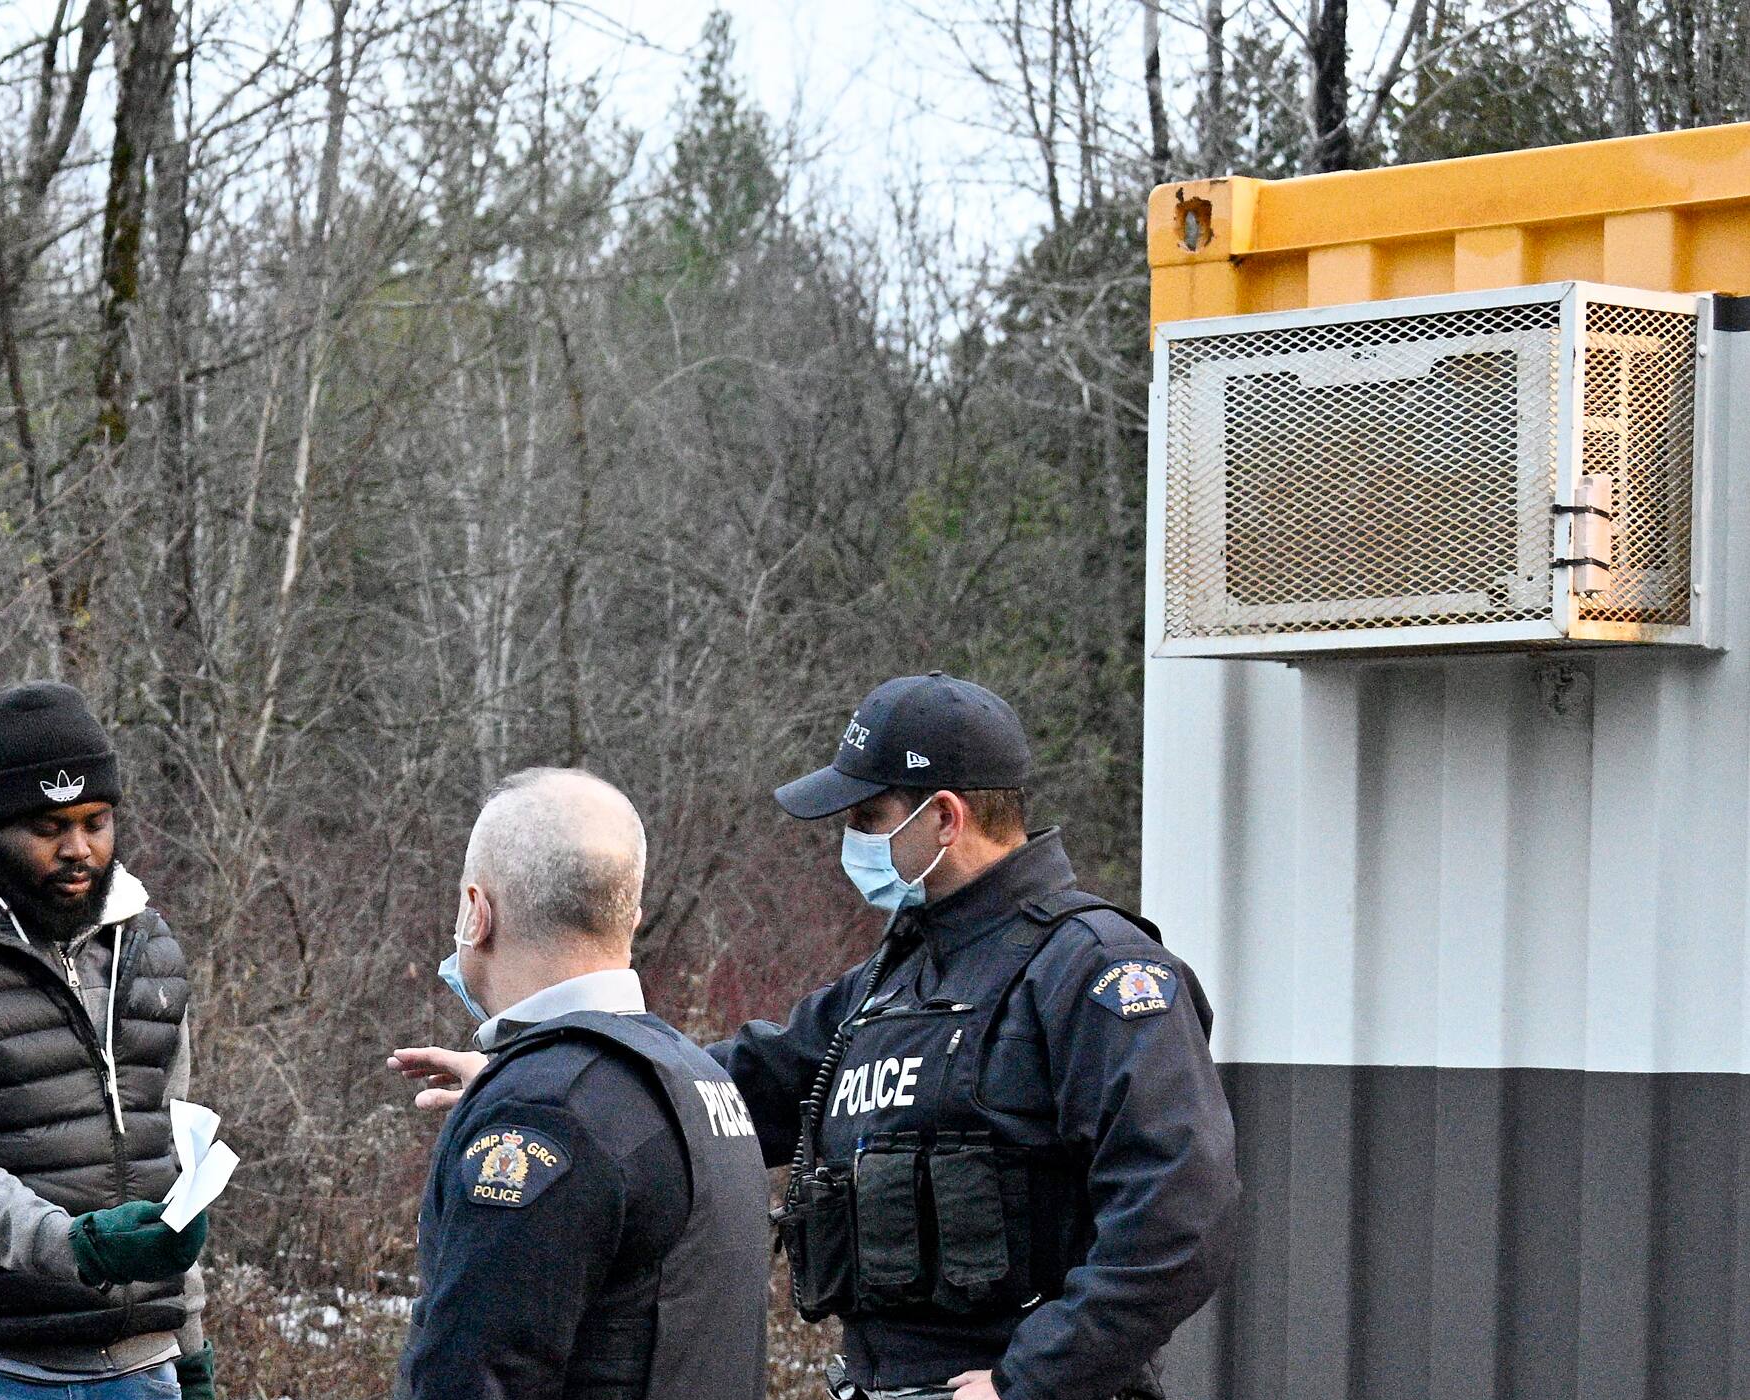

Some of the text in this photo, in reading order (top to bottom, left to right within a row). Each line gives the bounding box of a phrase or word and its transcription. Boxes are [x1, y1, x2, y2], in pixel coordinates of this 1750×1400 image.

[1093, 965, 1169, 995] RCMP GRC
[1122, 999, 1167, 1015] POLICE
[831, 1057, 923, 1117] POLICE
[693, 1080, 755, 1137] POLICE
[466, 1134, 557, 1167] RCMP GRC
[473, 1185, 522, 1203] POLICE
